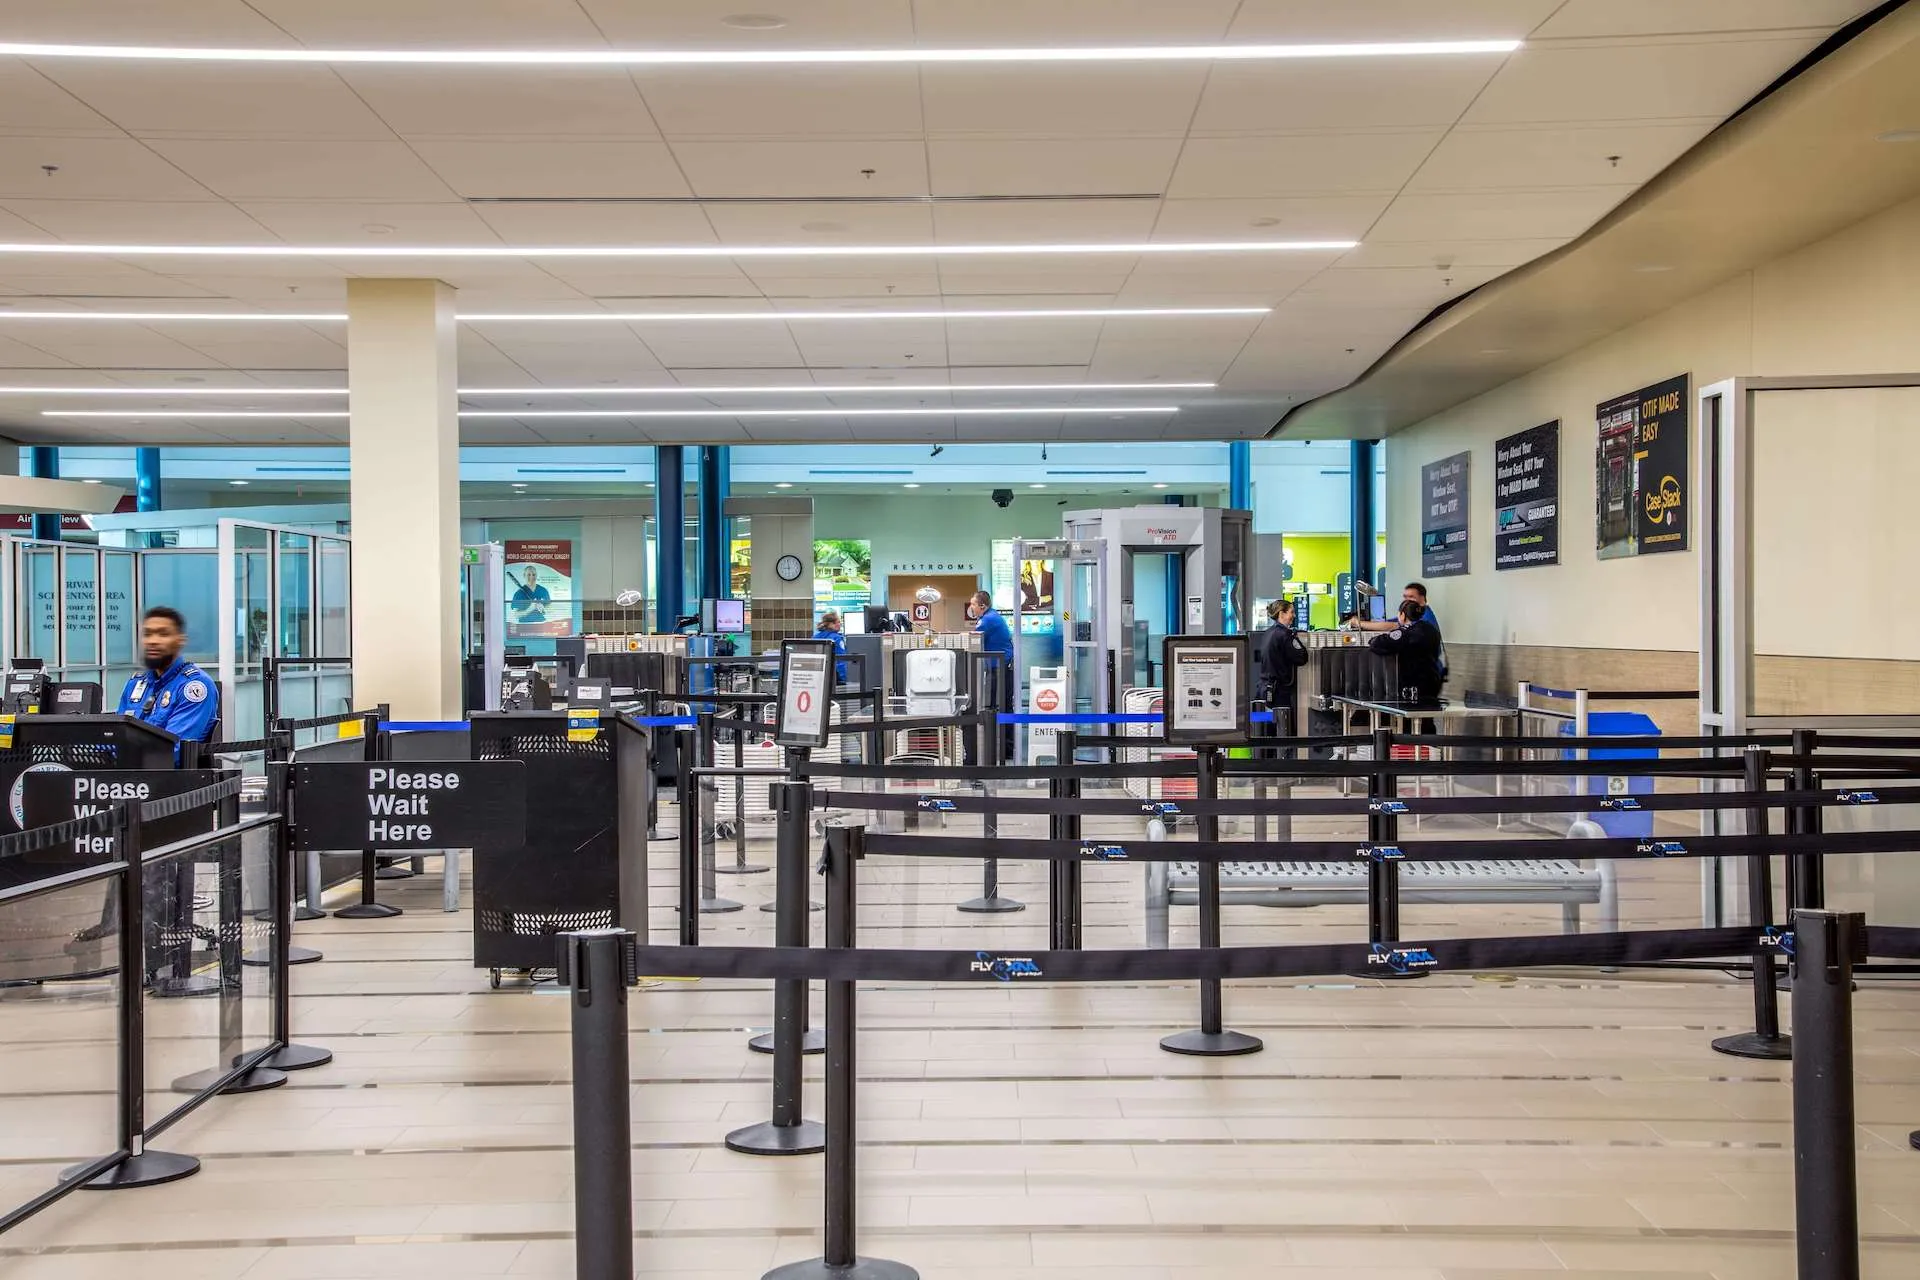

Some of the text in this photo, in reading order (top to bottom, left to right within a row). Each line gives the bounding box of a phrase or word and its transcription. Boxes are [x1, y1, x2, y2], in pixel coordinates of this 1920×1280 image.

[1642, 399, 1657, 419] OTIF
[1658, 391, 1680, 414] MADE
[1642, 422, 1659, 442] EASY
[1498, 442, 1532, 462] Worry About Your
[1498, 466, 1512, 479] Window
[1523, 458, 1533, 472] NOT
[1533, 457, 1544, 470] Your
[1501, 484, 1509, 497] Day
[1528, 505, 1556, 520] GUARANTEED
[106, 591, 126, 600] REA
[369, 768, 460, 789] Please
[74, 778, 150, 800] Please
[368, 794, 429, 815] Wait
[369, 820, 432, 841] Here
[74, 833, 115, 854] Her
[1080, 847, 1096, 855] FLY
[1356, 848, 1372, 856] FLY
[1637, 844, 1653, 852] FLY
[1759, 935, 1782, 946] FLY
[970, 961, 993, 972] FLY
[1367, 953, 1390, 965] FLY
